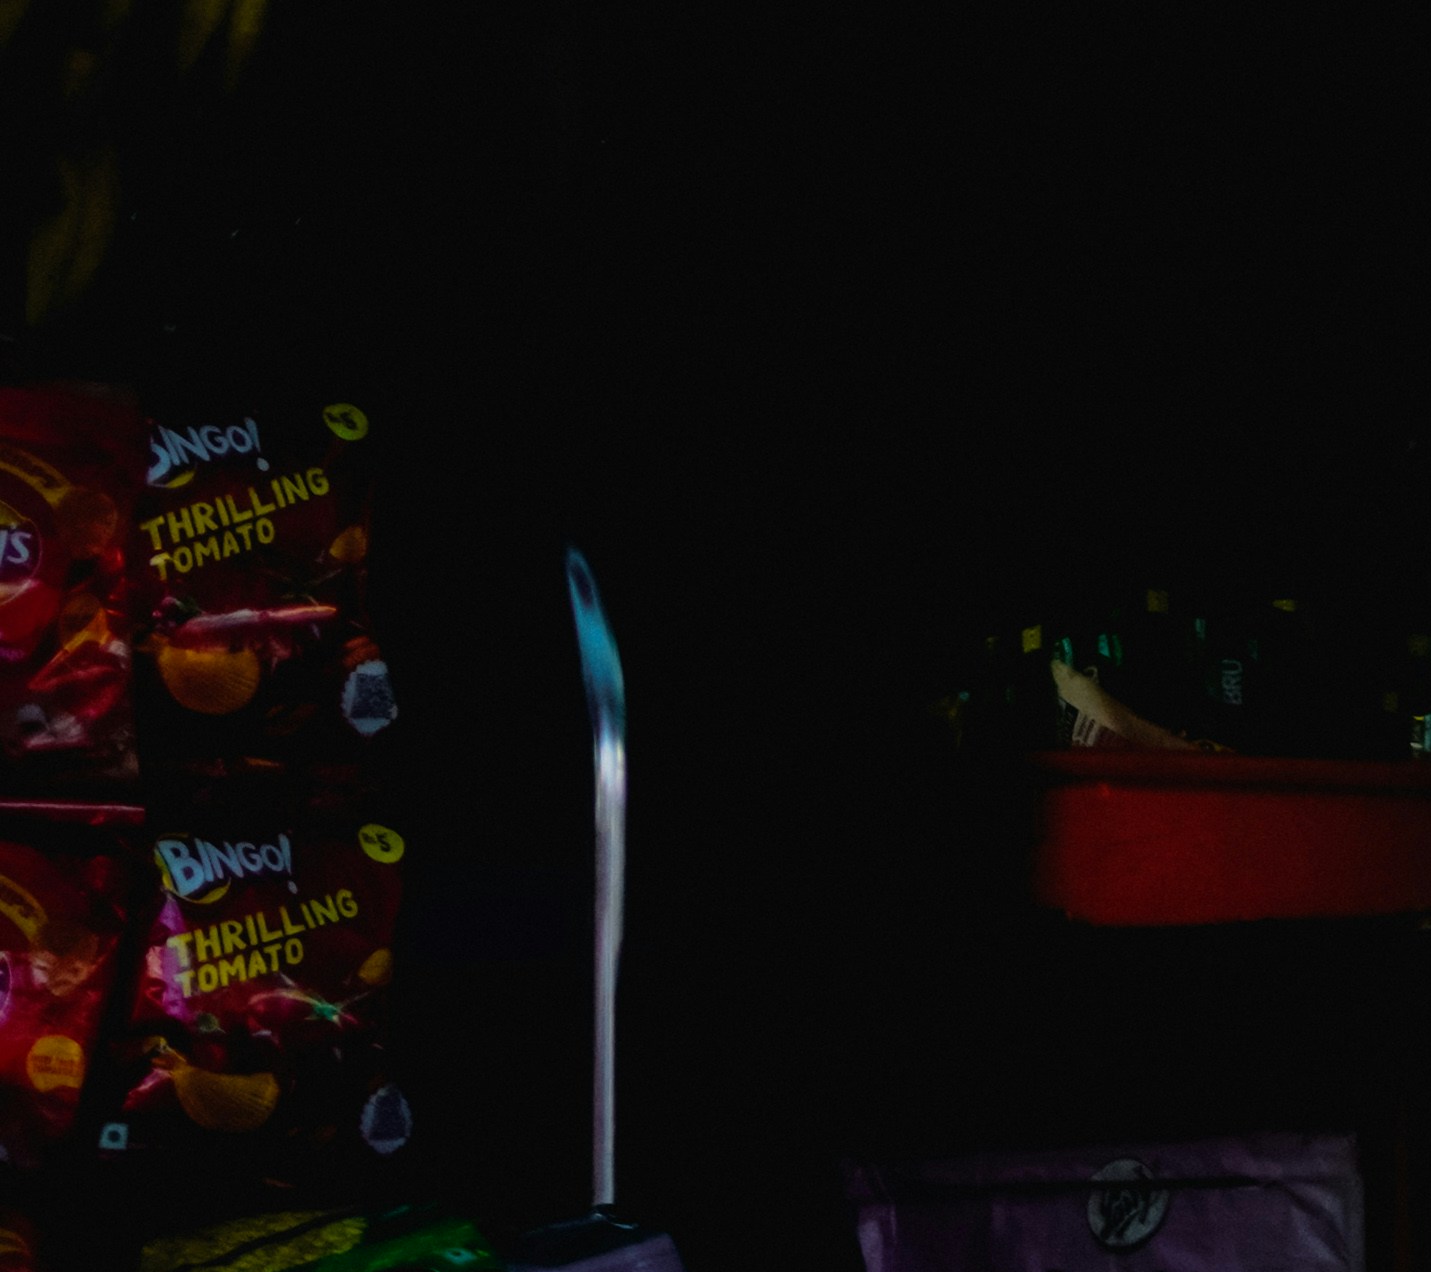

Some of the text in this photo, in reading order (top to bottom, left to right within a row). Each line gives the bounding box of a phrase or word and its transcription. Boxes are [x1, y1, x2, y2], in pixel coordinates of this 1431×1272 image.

[141, 467, 331, 550] THRILLING
[149, 517, 275, 581] TOMATO
[1220, 658, 1244, 704] BRU
[155, 833, 299, 899] BINGO!
[166, 888, 360, 968] THRILLING
[175, 938, 305, 998] TOMATO
